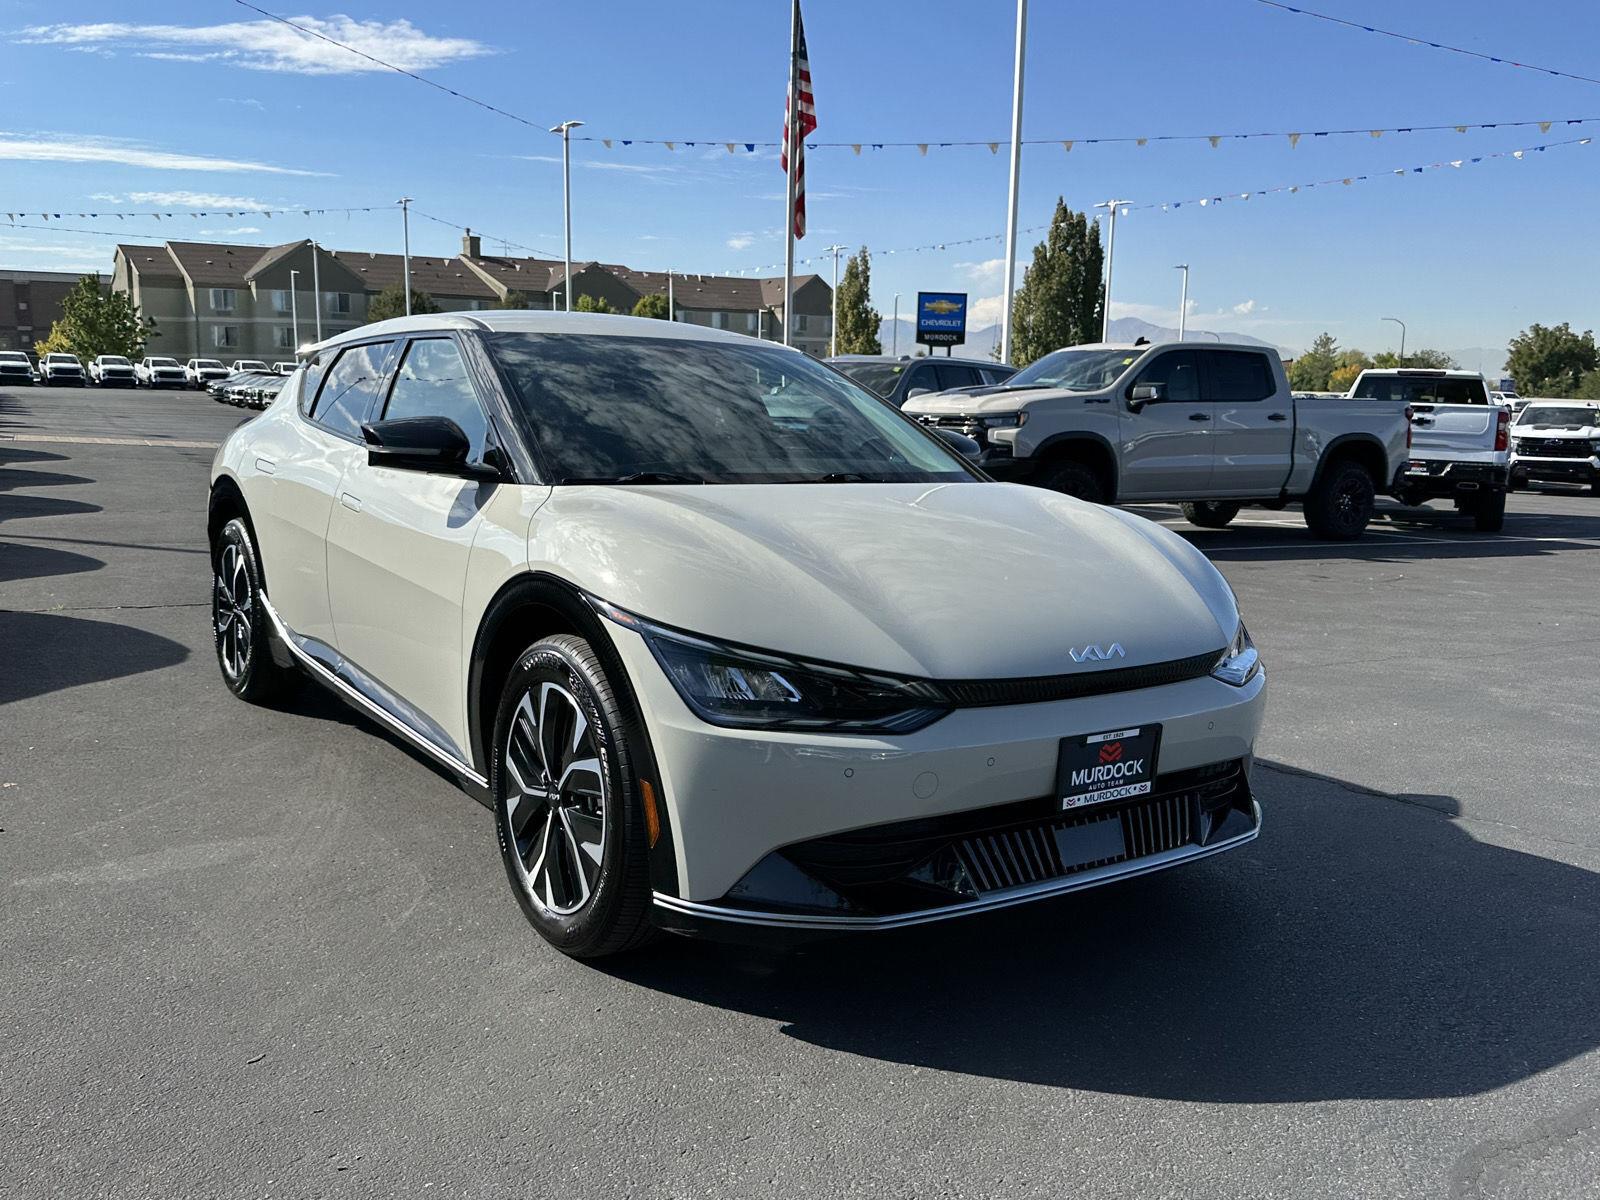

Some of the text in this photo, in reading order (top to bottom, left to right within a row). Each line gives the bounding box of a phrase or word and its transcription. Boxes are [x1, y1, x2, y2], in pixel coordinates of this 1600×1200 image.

[921, 319, 961, 327] CHEVROLET
[1071, 759, 1144, 787] MURDOCK
[1088, 779, 1124, 790] AUTO TEAM
[1084, 786, 1132, 804] MURDOCK
